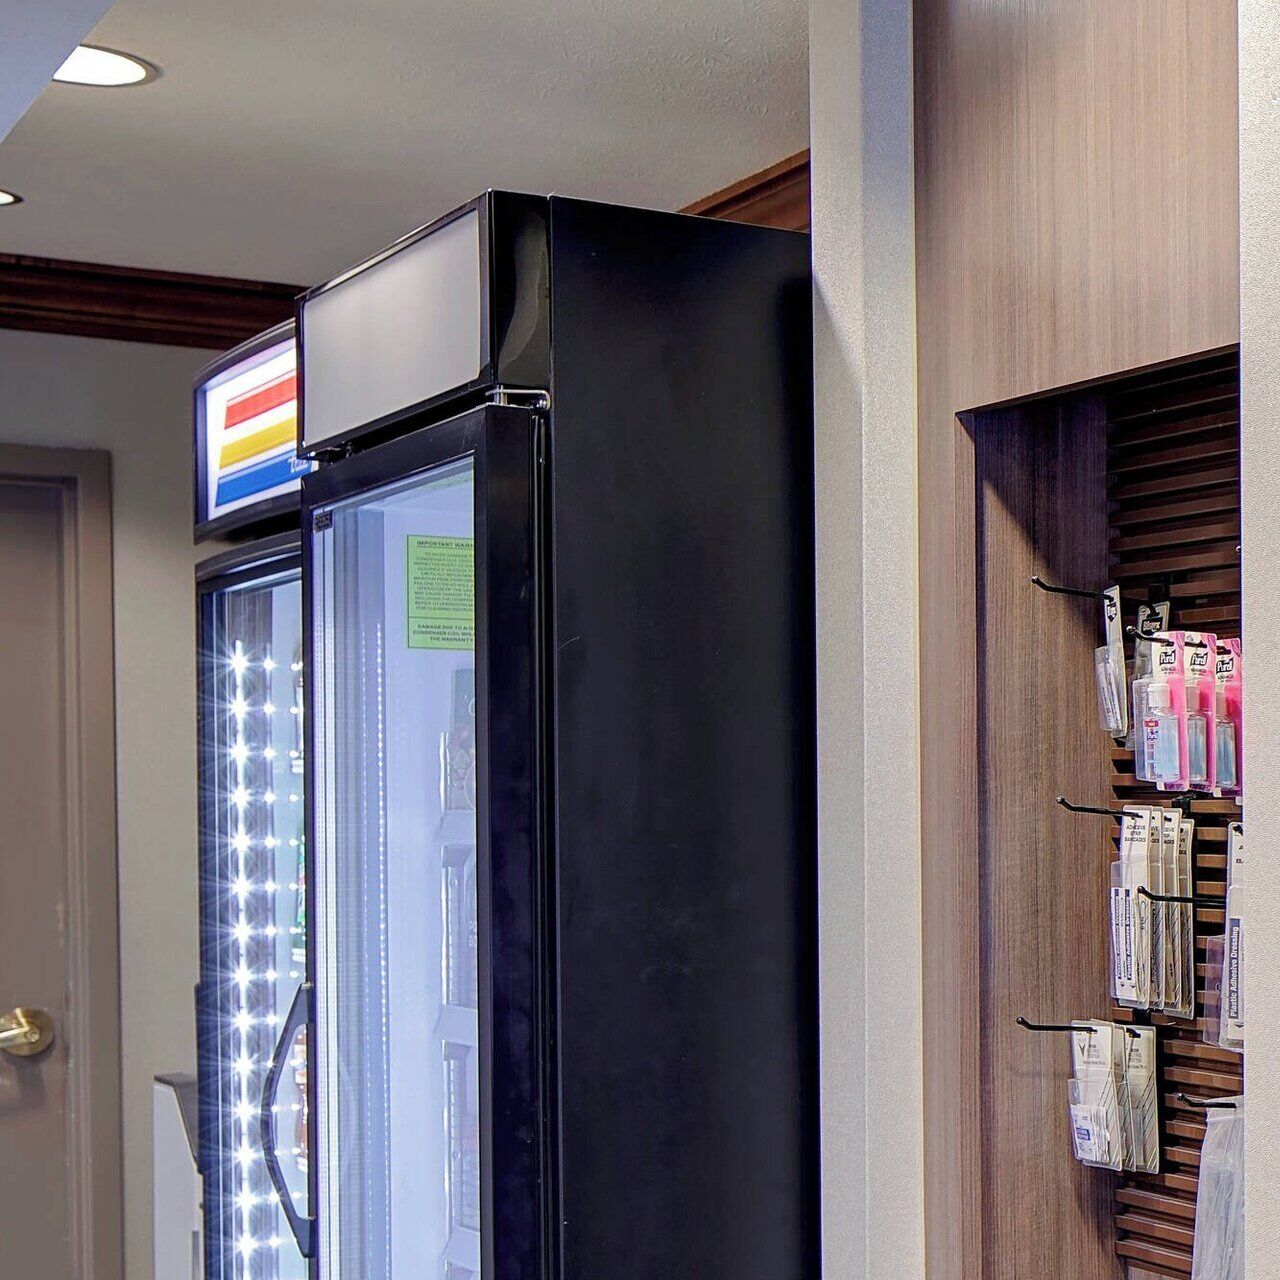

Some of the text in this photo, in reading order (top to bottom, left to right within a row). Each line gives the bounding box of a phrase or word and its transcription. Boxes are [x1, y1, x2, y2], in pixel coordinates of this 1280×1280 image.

[1229, 926, 1239, 1017] Plastic Adhesive Dressing
